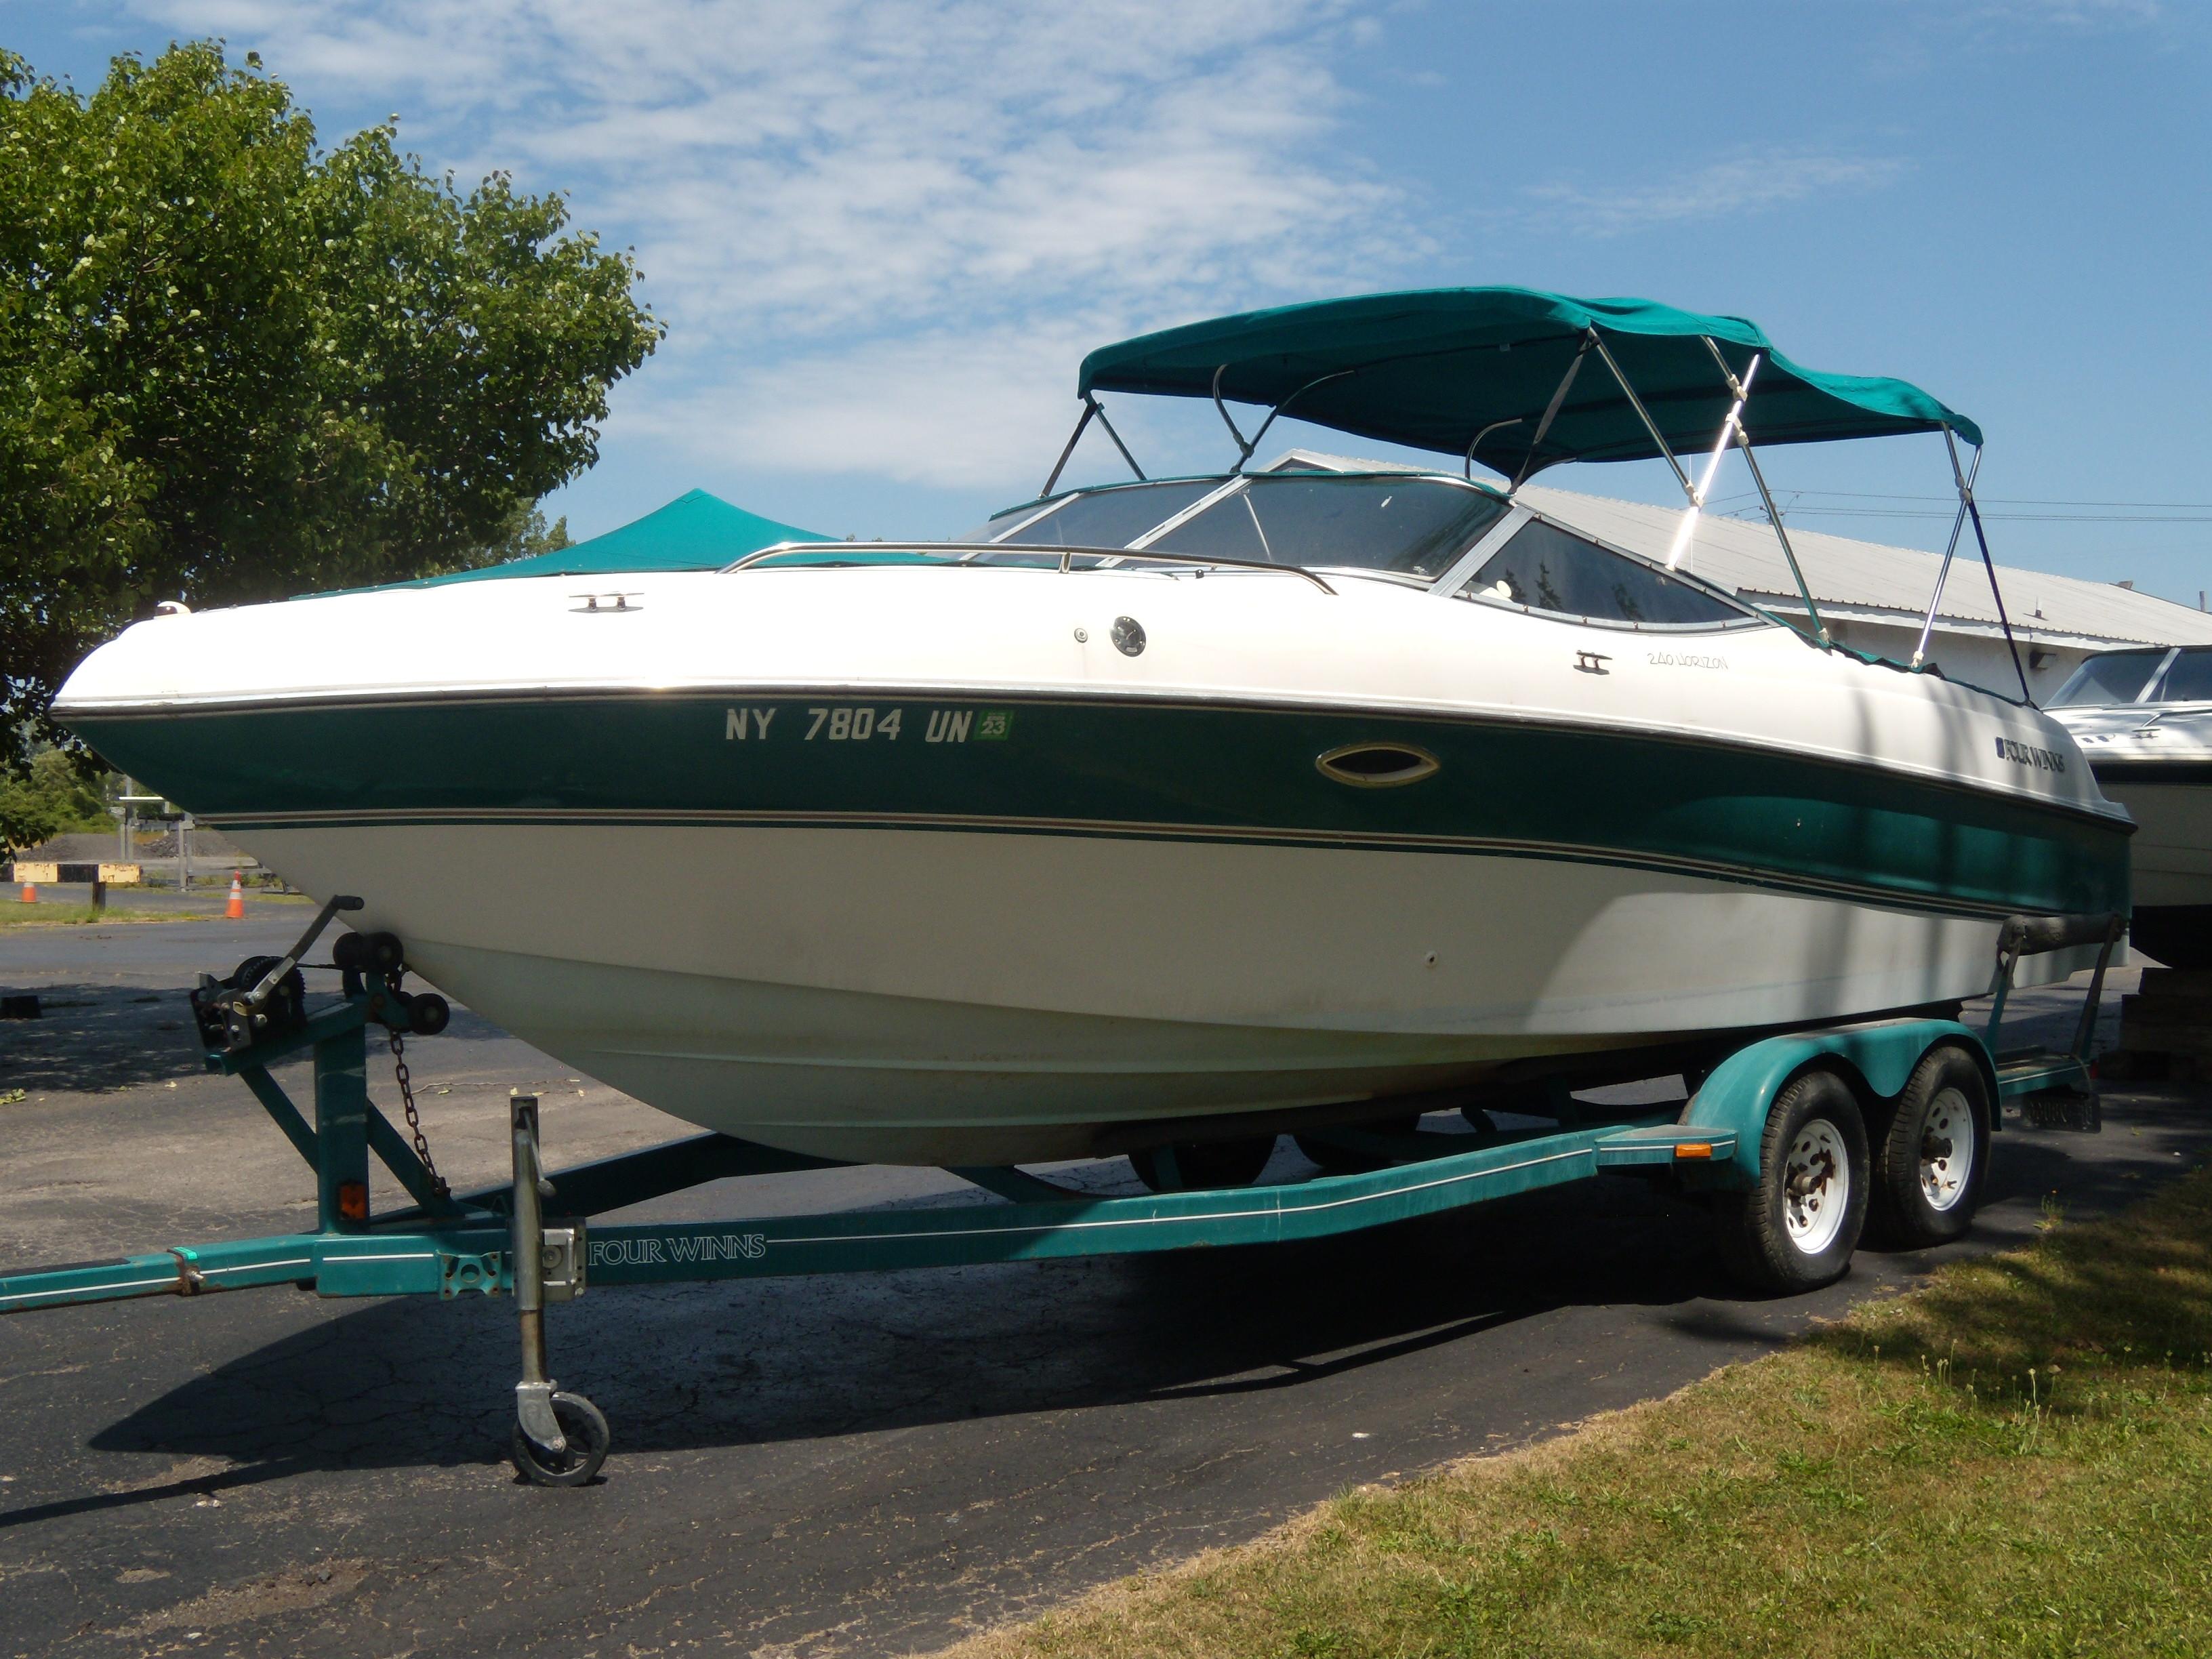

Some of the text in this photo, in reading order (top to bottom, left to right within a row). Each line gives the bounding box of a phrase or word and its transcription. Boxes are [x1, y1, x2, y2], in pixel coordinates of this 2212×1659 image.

[1647, 652, 1673, 665] 240
[726, 708, 973, 743] NY 7804 UN
[2004, 739, 2065, 772] FOUR WINNS
[588, 1234, 766, 1266] FOUR WINNS
